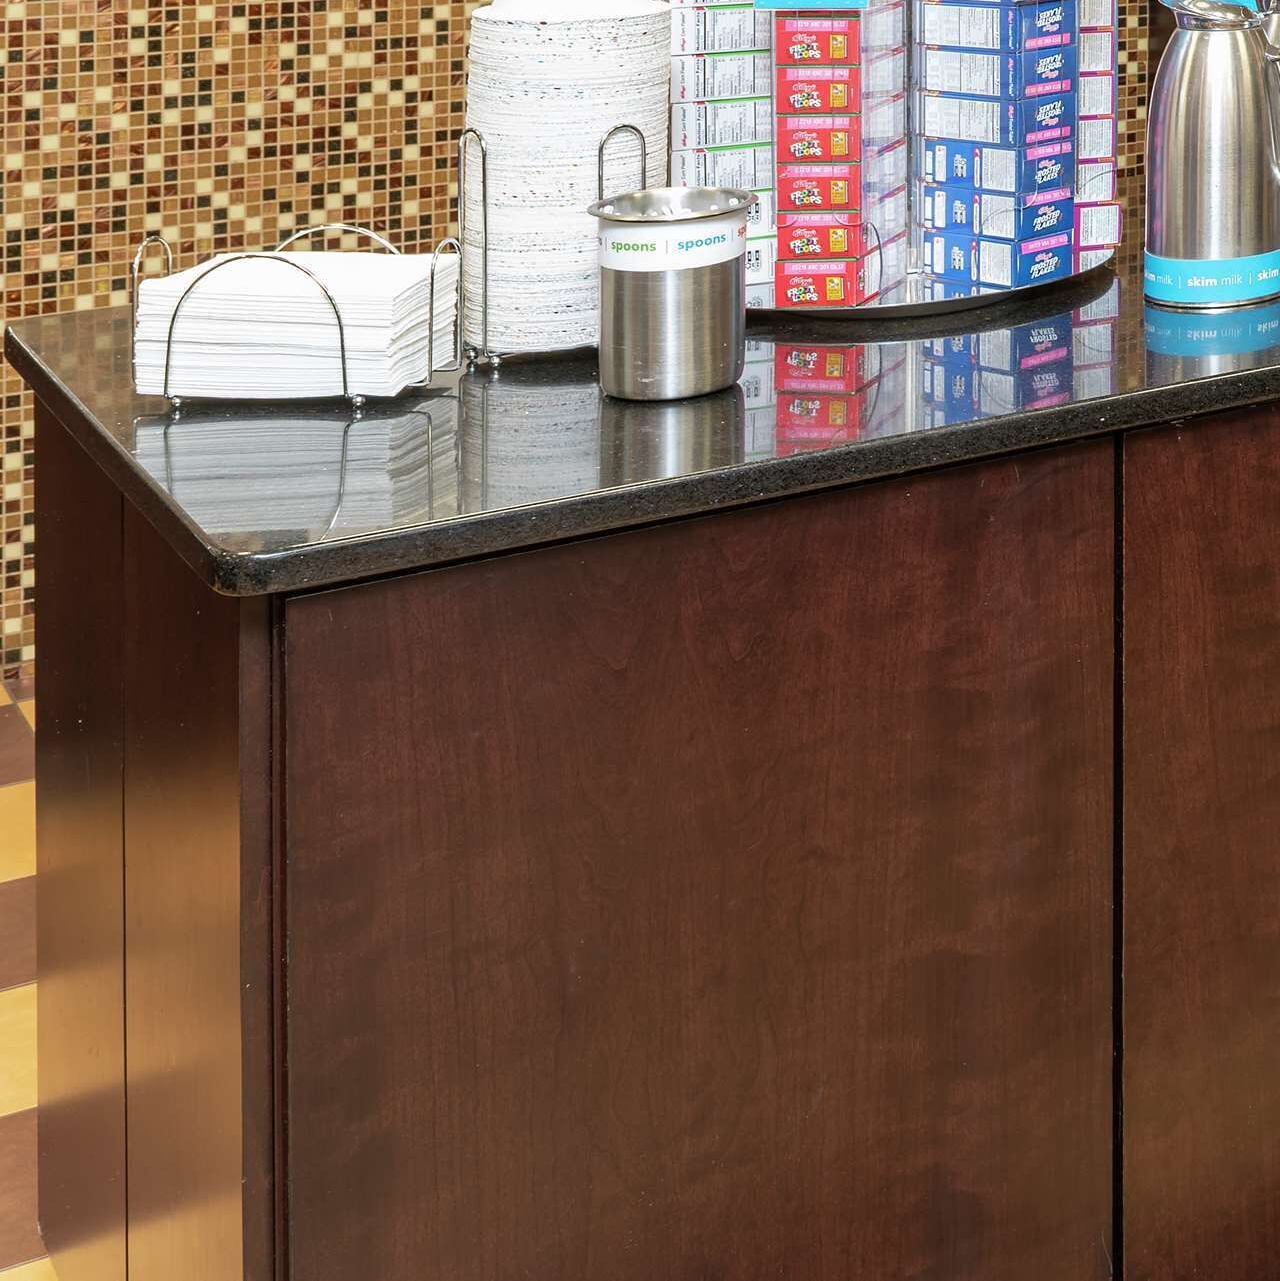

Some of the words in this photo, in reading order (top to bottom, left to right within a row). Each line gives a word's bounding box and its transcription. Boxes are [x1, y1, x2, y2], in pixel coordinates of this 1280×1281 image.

[789, 42, 819, 54] FROOT
[794, 50, 821, 59] LOOPS
[789, 91, 819, 103] FROOT
[794, 99, 821, 108] LOOPS
[790, 140, 819, 152] FROOT
[795, 148, 822, 157] LOOPS
[1035, 164, 1061, 180] FROSTED
[1038, 173, 1058, 184] FLAKES
[790, 188, 819, 200] FROOT
[795, 195, 822, 205] LOOPS
[1033, 209, 1060, 226] FROSTED
[1034, 219, 1057, 231] FLAKES
[611, 240, 656, 254] spoons
[677, 234, 726, 252] spoons
[789, 236, 819, 249] FROOT
[795, 244, 821, 253] LOOPS
[1030, 256, 1059, 273] FROSTED
[1031, 265, 1055, 279] FLAKES
[1257, 268, 1279, 282] skim
[1156, 272, 1174, 286] milk
[1187, 276, 1217, 288] skim
[1220, 273, 1243, 286] milk
[786, 285, 815, 297] FROOT
[792, 292, 818, 302] LOOPS
